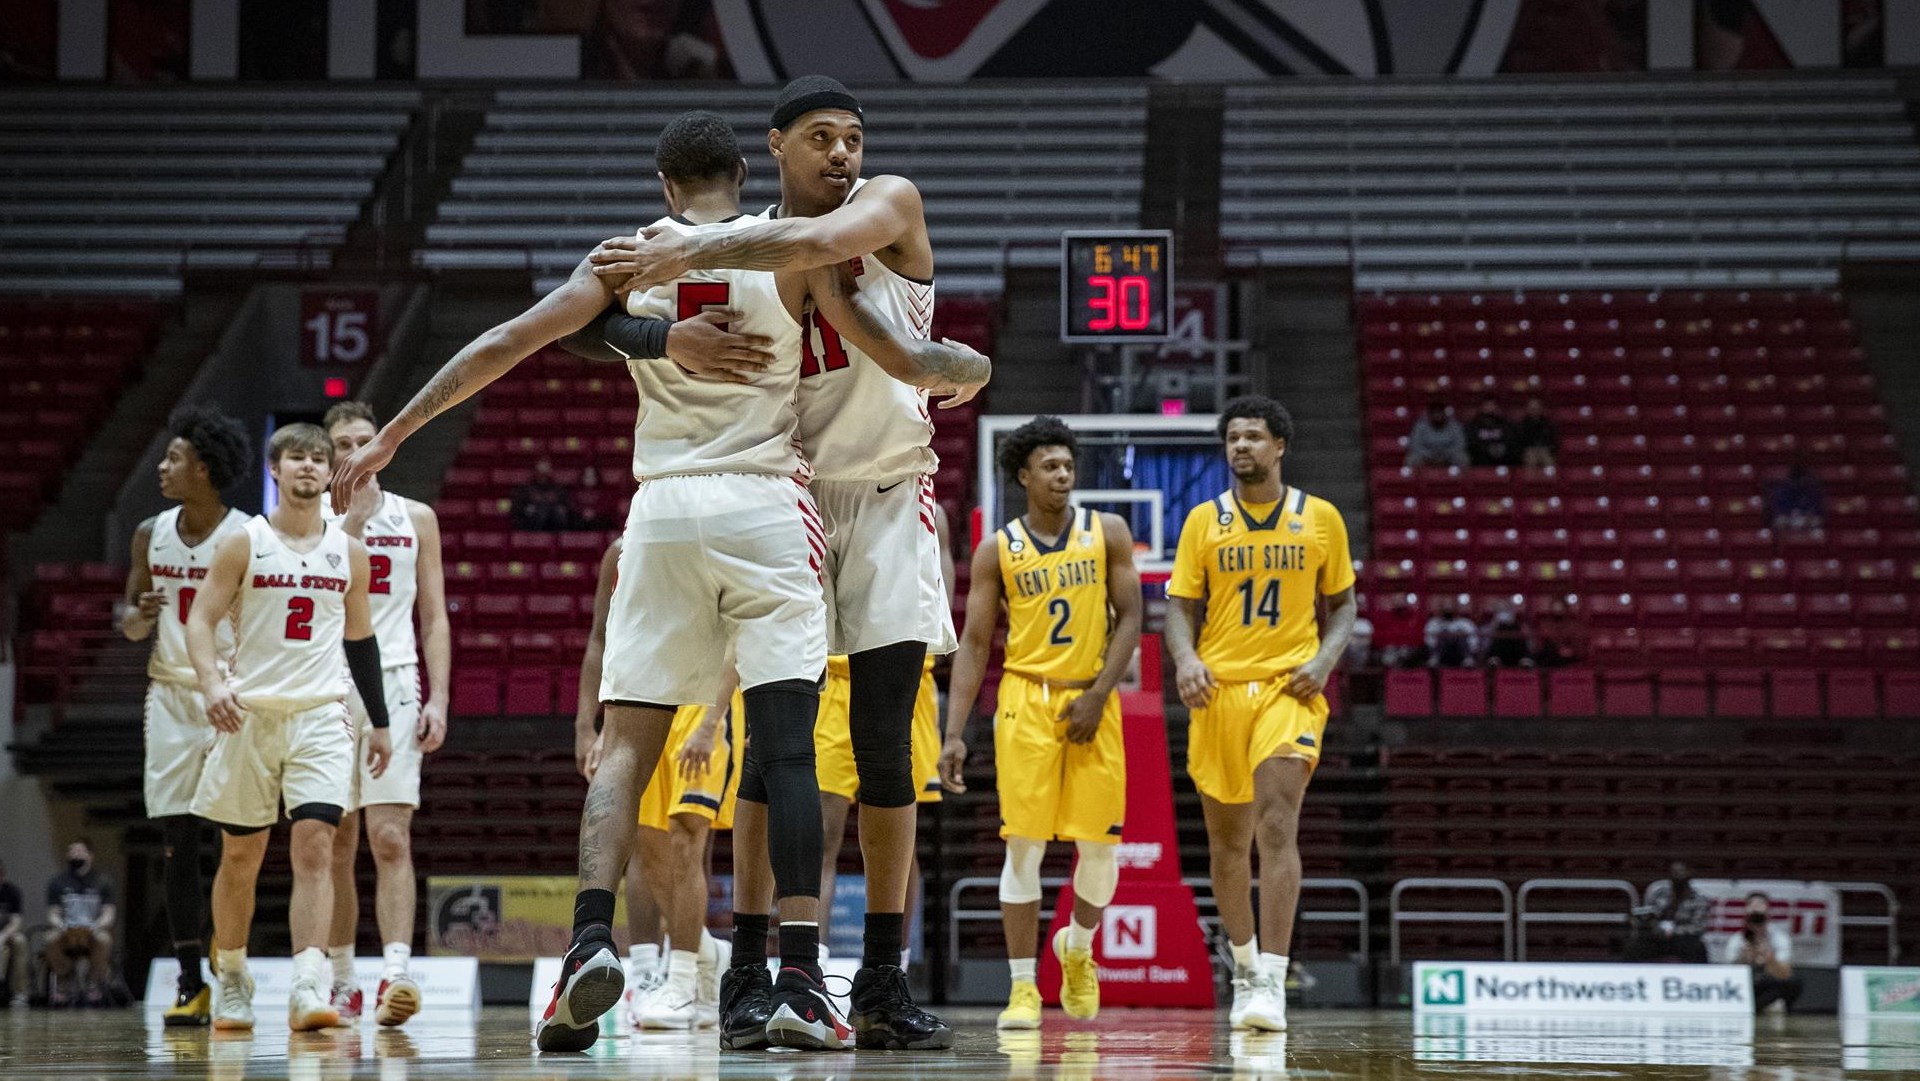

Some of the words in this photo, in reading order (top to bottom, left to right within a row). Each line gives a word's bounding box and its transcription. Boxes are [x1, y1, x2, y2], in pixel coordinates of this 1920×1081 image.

[1088, 275, 1149, 330] 30
[304, 312, 369, 361] 15
[366, 535, 412, 548] STATE
[1218, 546, 1254, 572] KENT
[1264, 545, 1304, 571] STATE
[151, 564, 184, 579] BALL
[252, 574, 297, 589] BALL
[301, 575, 348, 593] STATE
[1014, 568, 1051, 598] KENT
[1058, 559, 1096, 588] STATE
[285, 595, 315, 641] 2
[1237, 577, 1281, 627] 14
[1048, 598, 1073, 645] 2
[1149, 965, 1188, 983] Bank
[1474, 974, 1649, 1000] Northwest
[1661, 975, 1744, 1004] Bank
